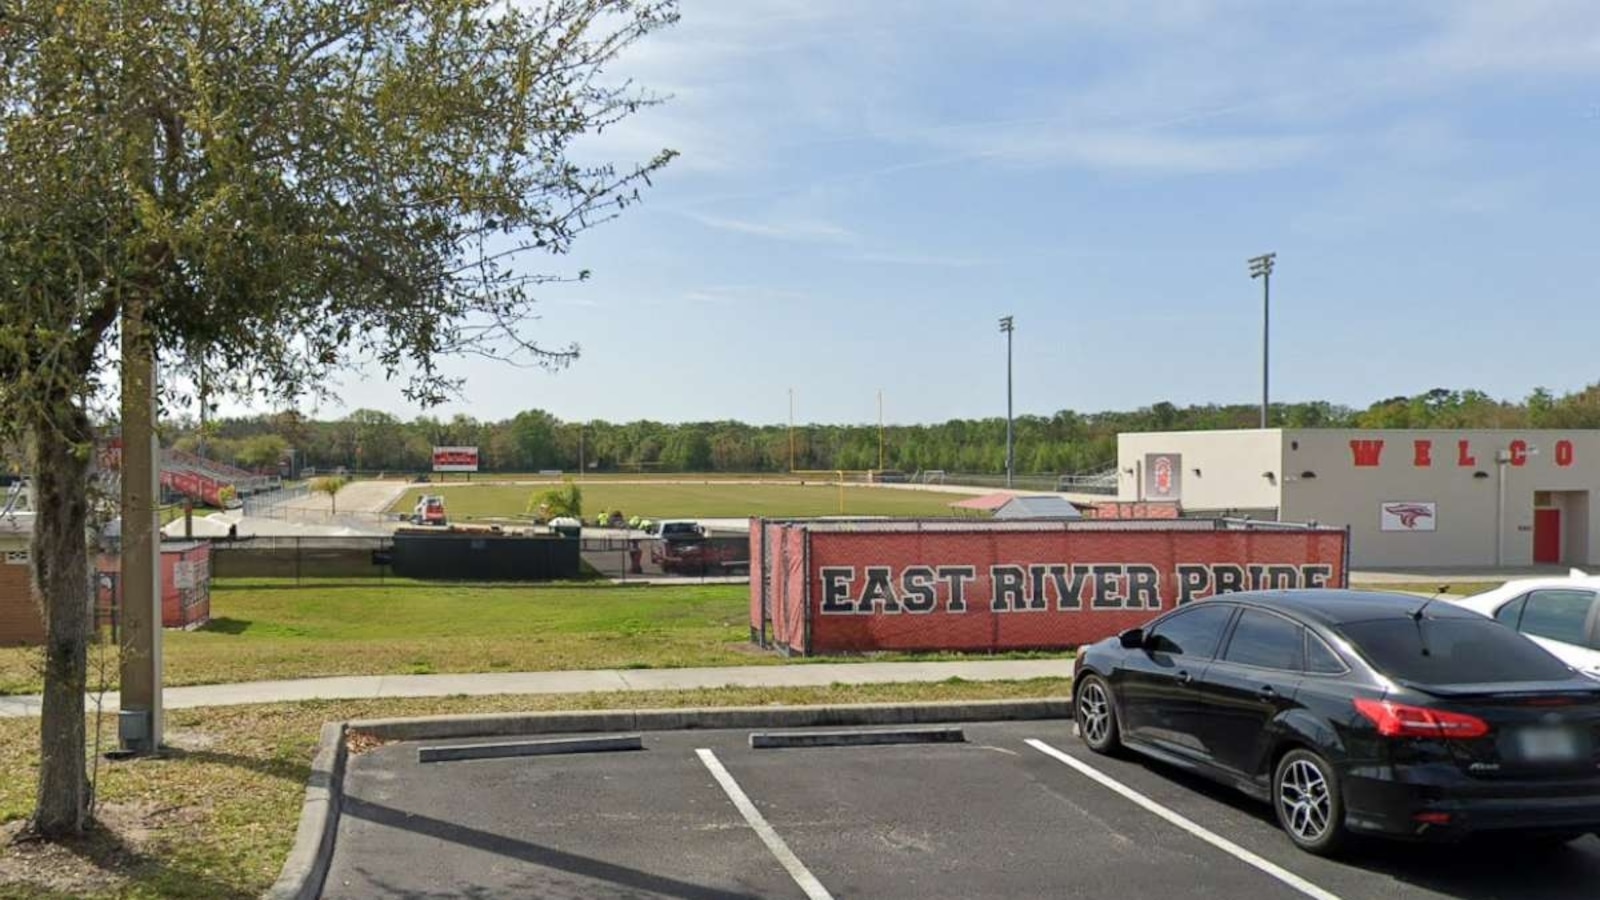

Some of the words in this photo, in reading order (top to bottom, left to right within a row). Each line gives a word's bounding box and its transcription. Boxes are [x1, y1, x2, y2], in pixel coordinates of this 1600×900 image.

[819, 565, 976, 616] EAST
[990, 563, 1161, 613] RIVER
[1175, 563, 1333, 607] PRIDE
